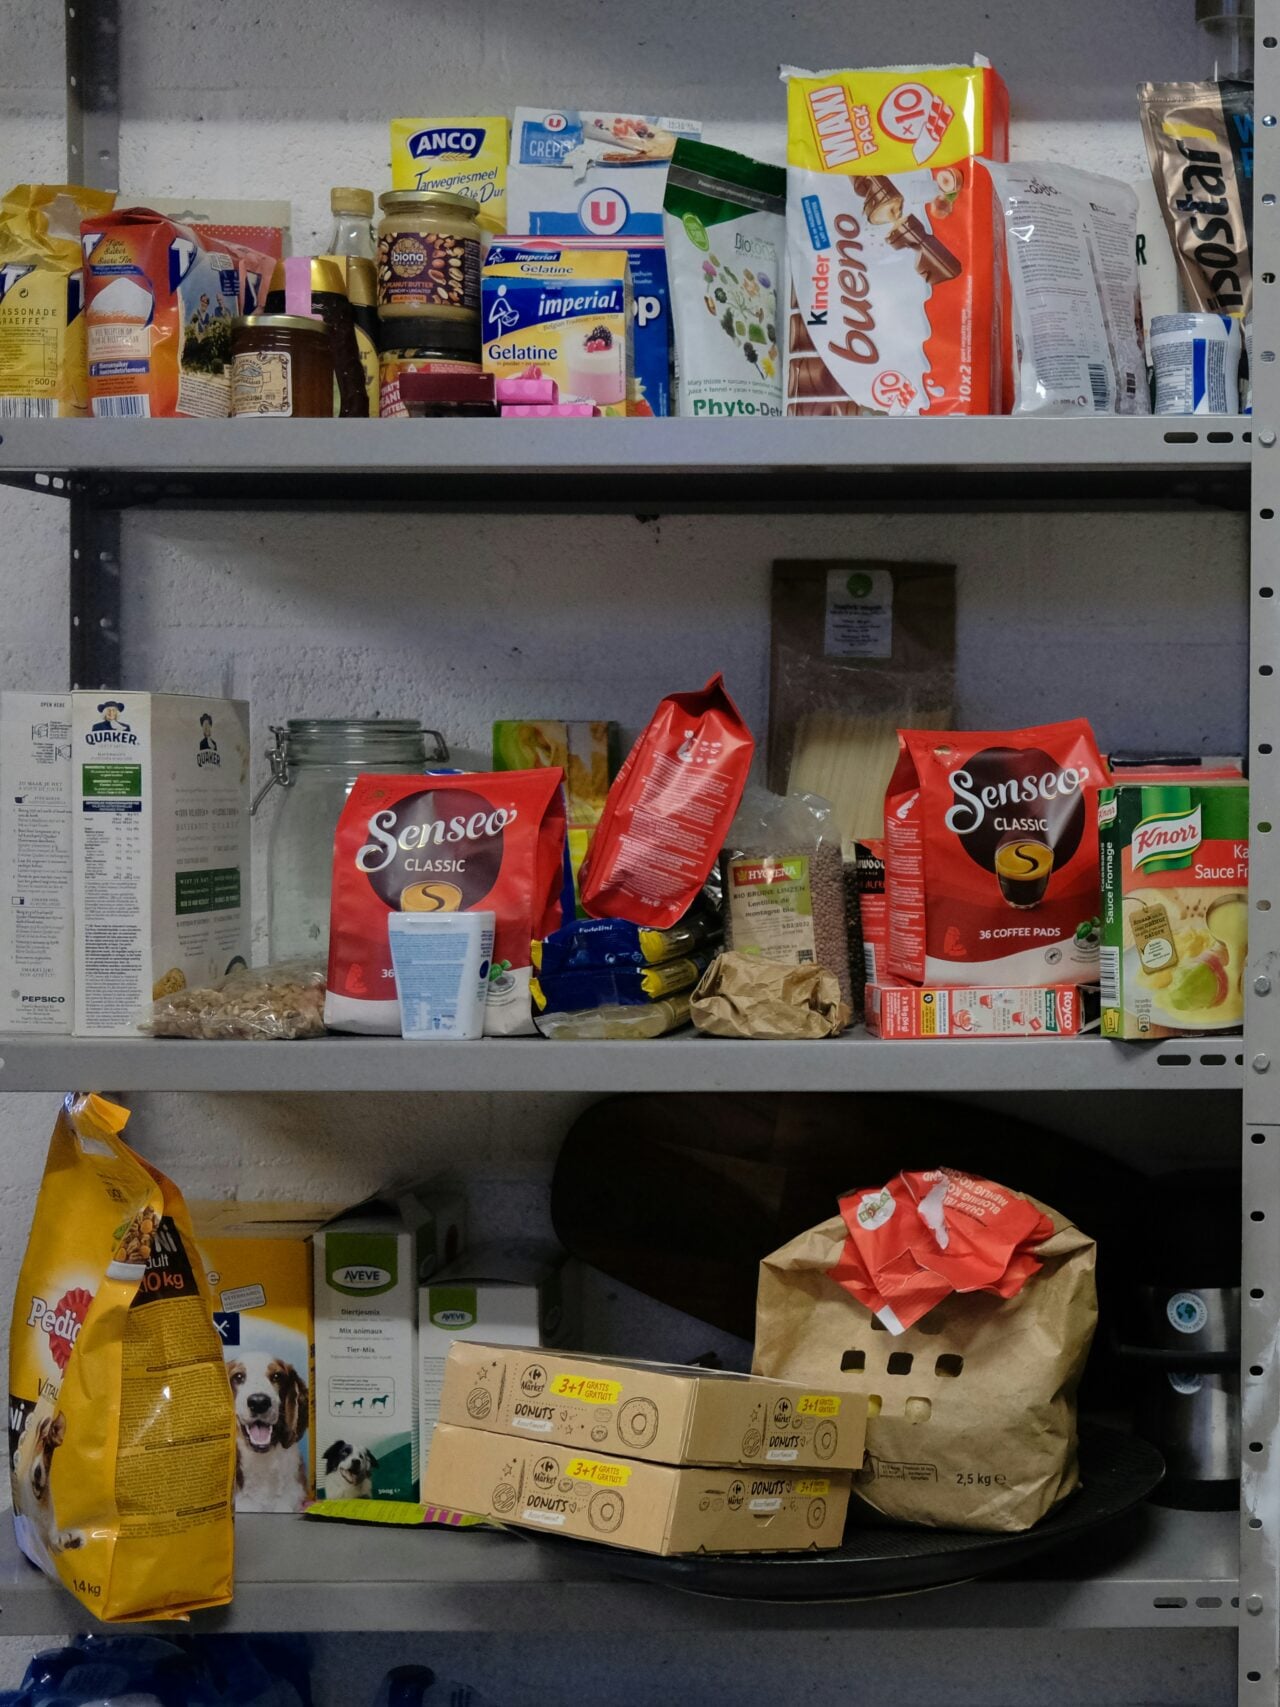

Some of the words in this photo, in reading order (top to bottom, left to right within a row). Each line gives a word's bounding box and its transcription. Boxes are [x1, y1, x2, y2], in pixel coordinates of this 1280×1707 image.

[549, 118, 562, 128] U
[809, 86, 860, 167] MAXI
[853, 104, 878, 154] PACK
[416, 132, 476, 154] ANCO
[414, 167, 499, 191] Tarwegriesmeel
[480, 182, 505, 203] Dur
[591, 201, 617, 226] U
[393, 251, 424, 262] biona
[515, 252, 558, 262] imperial
[520, 264, 574, 275] Gelatine
[828, 212, 880, 364] bueno
[538, 290, 617, 317] imperial
[488, 344, 559, 361] Gelatine
[84, 730, 138, 746] QUAKER
[196, 751, 222, 768] QUAKER
[944, 765, 1090, 834] Senseo
[993, 816, 1049, 833] CLASSIC
[354, 802, 518, 872] Senseo
[1133, 822, 1200, 854] Knorr
[404, 858, 466, 873] CLASSIC
[1106, 841, 1115, 893] Fromage
[1195, 864, 1235, 880] Sauce
[733, 892, 746, 900] BIO
[747, 889, 774, 898] BRUINE
[776, 886, 806, 895] LINZEN
[744, 908, 781, 918] montagne
[1106, 895, 1114, 924] Sauce
[979, 930, 991, 939] 36
[992, 928, 1031, 939] COFFEE
[1033, 926, 1062, 937] PADS
[381, 968, 395, 979] 36
[21, 995, 65, 1004] PEPSICO
[1059, 991, 1073, 1029] Royco
[162, 1271, 185, 1289] kg
[344, 1270, 380, 1281] AVEVE
[341, 1308, 381, 1317] Diertjesmix
[441, 1312, 466, 1321] AVEVE
[338, 1327, 351, 1335] Mix
[352, 1327, 383, 1335] animaux
[521, 1381, 546, 1393] Market
[558, 1378, 586, 1396] 3+1
[586, 1382, 610, 1392] GRATIS
[584, 1390, 612, 1401] GRATUIT
[514, 1403, 556, 1420] DONUTS
[801, 1398, 819, 1412] 3+1
[769, 1435, 801, 1448] DONUTS
[533, 1472, 558, 1483] Market
[573, 1462, 598, 1478] 3+1
[598, 1464, 620, 1476] GRATIS
[597, 1473, 622, 1483] GRATUIT
[956, 1473, 974, 1487] 2,5
[976, 1472, 991, 1486] kg
[751, 1480, 785, 1495] DONUTS
[800, 1481, 813, 1492] 3+1
[526, 1494, 569, 1513] DONUTS
[88, 1582, 102, 1598] kg
